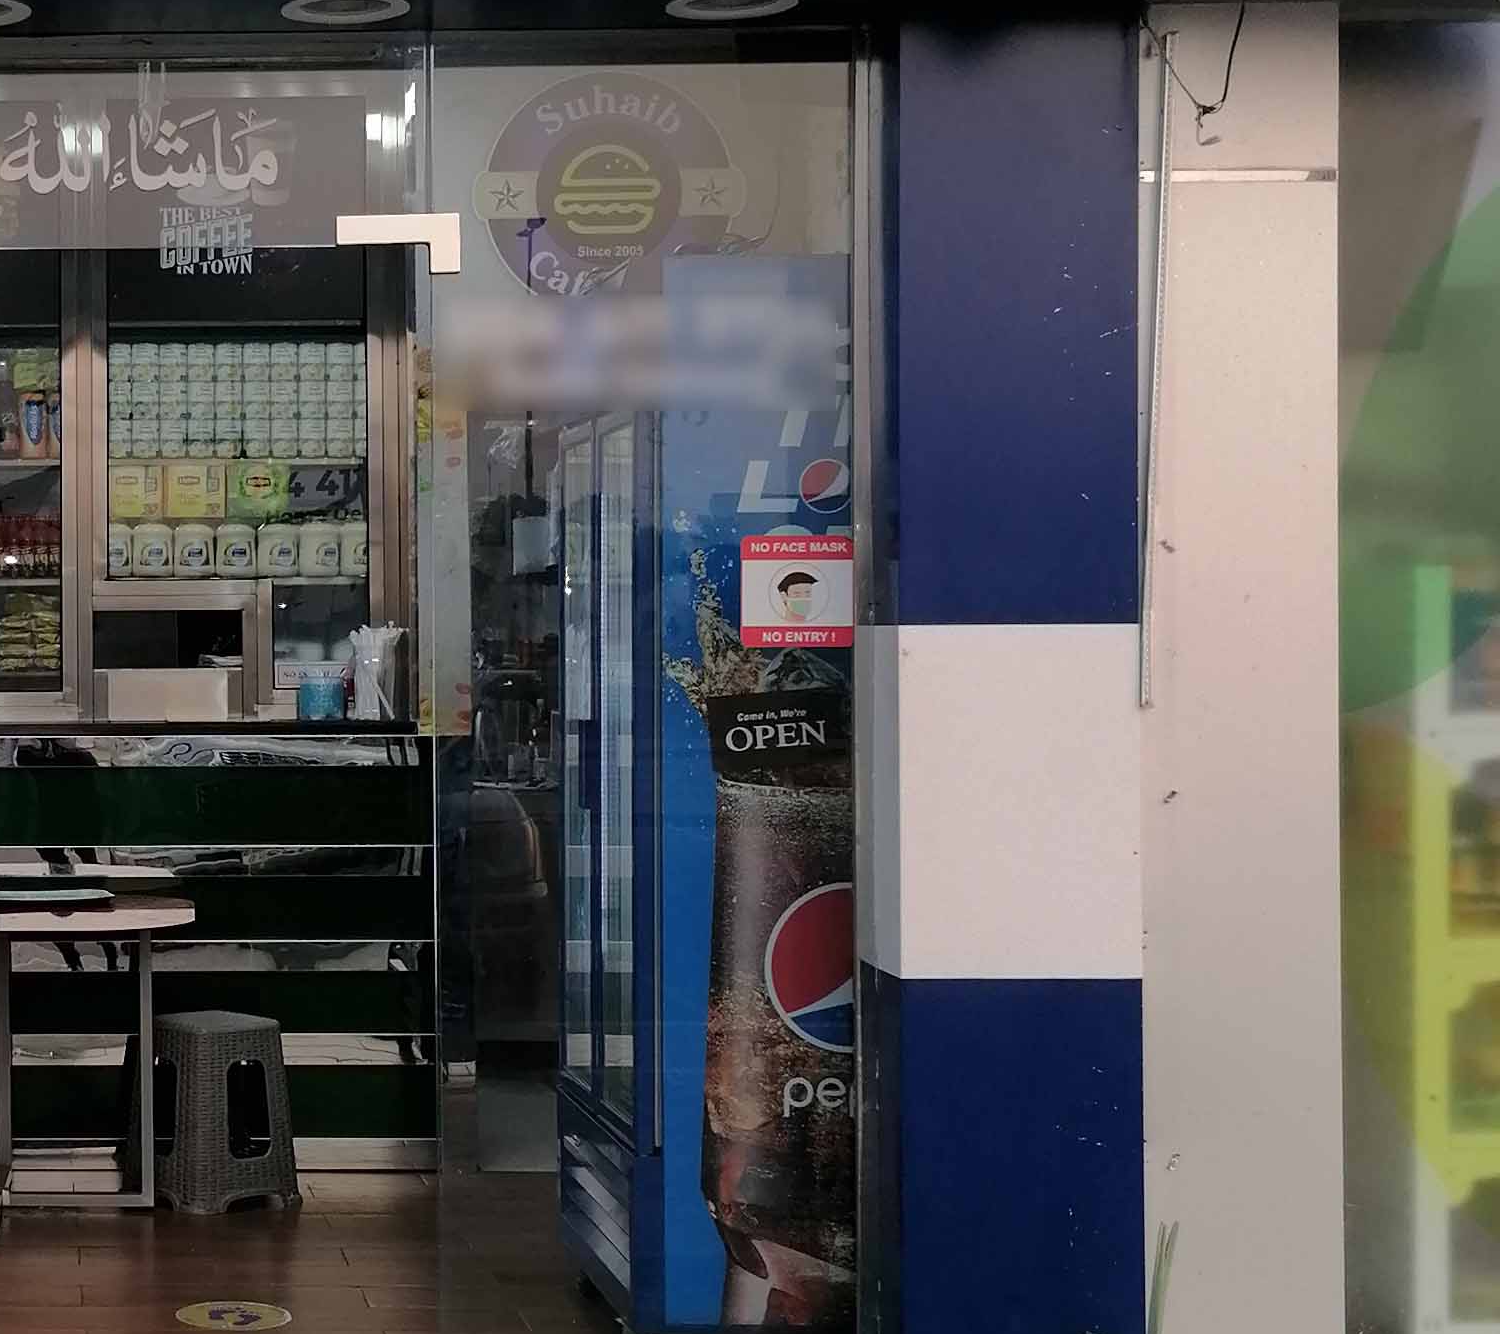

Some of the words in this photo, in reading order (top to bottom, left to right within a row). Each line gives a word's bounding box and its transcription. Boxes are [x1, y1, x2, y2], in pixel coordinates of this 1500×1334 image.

[536, 86, 681, 134] Suhaib
[159, 207, 196, 227] THE
[198, 205, 241, 221] BEST
[160, 213, 253, 269] COFFEE
[577, 245, 612, 259] Since
[176, 264, 195, 276] IN
[198, 254, 253, 276] TOWN
[750, 542, 771, 553] NO
[773, 542, 807, 553] FACE
[809, 542, 848, 553] MASK
[762, 631, 782, 642] NO
[785, 631, 827, 642] ENTRY
[736, 712, 764, 723] Come
[725, 720, 826, 752] OPEN
